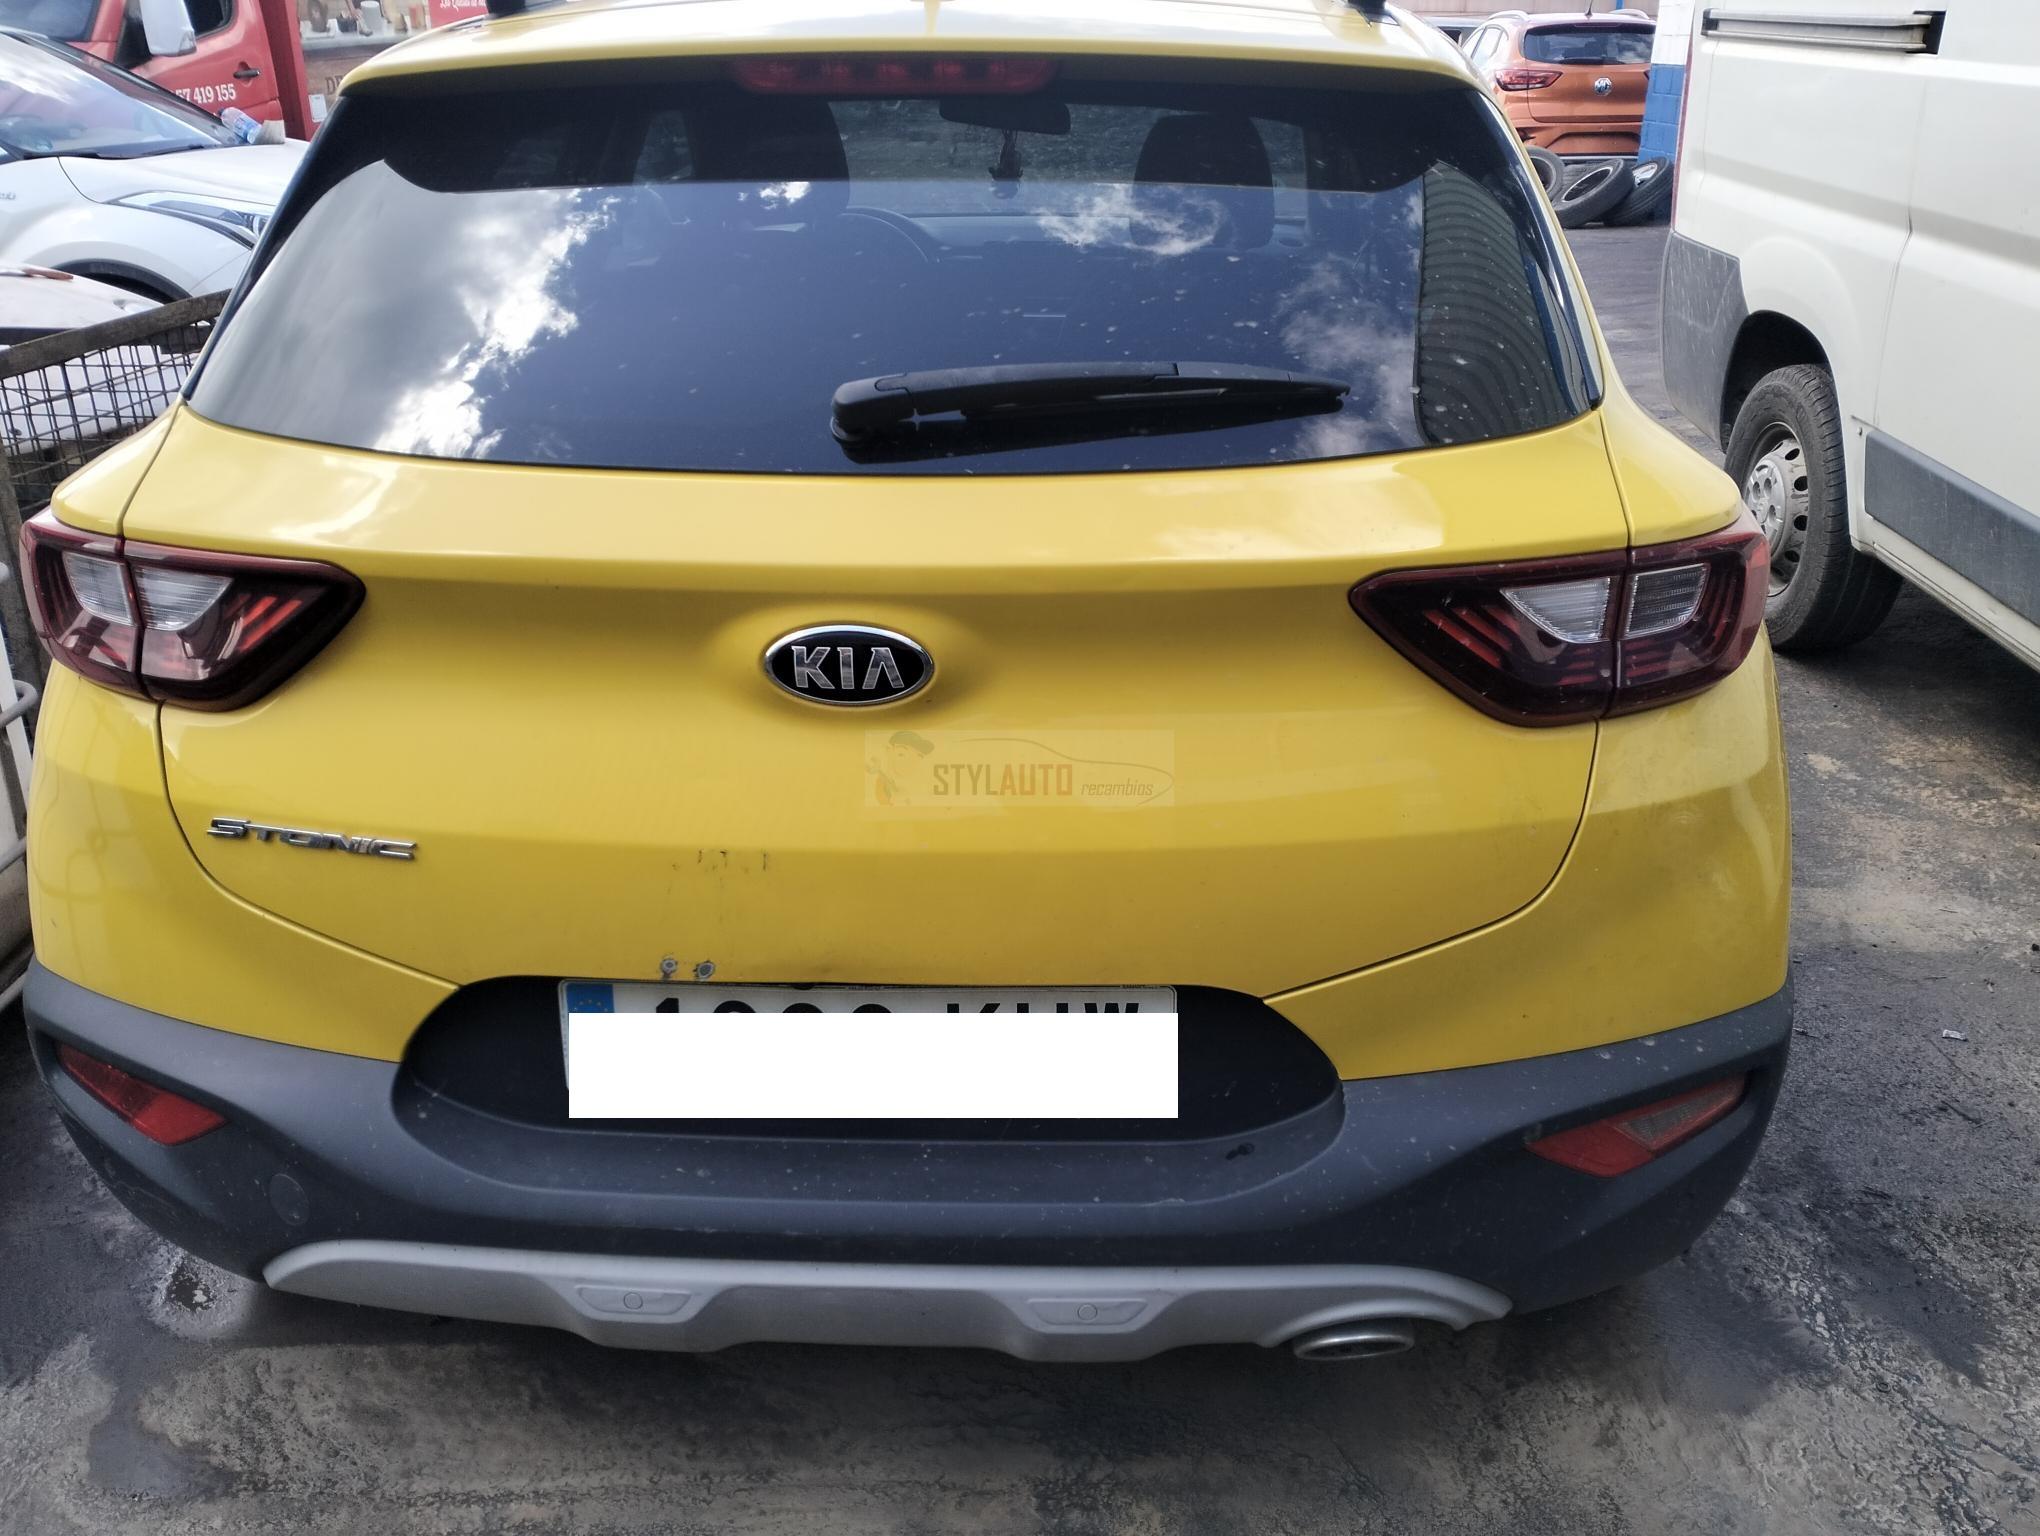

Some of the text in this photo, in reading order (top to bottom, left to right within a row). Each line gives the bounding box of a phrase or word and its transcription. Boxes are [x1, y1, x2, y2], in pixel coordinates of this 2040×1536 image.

[193, 85, 214, 104] 419
[215, 83, 236, 101] 155
[791, 645, 905, 690] KIA
[206, 817, 418, 861] STONIC
